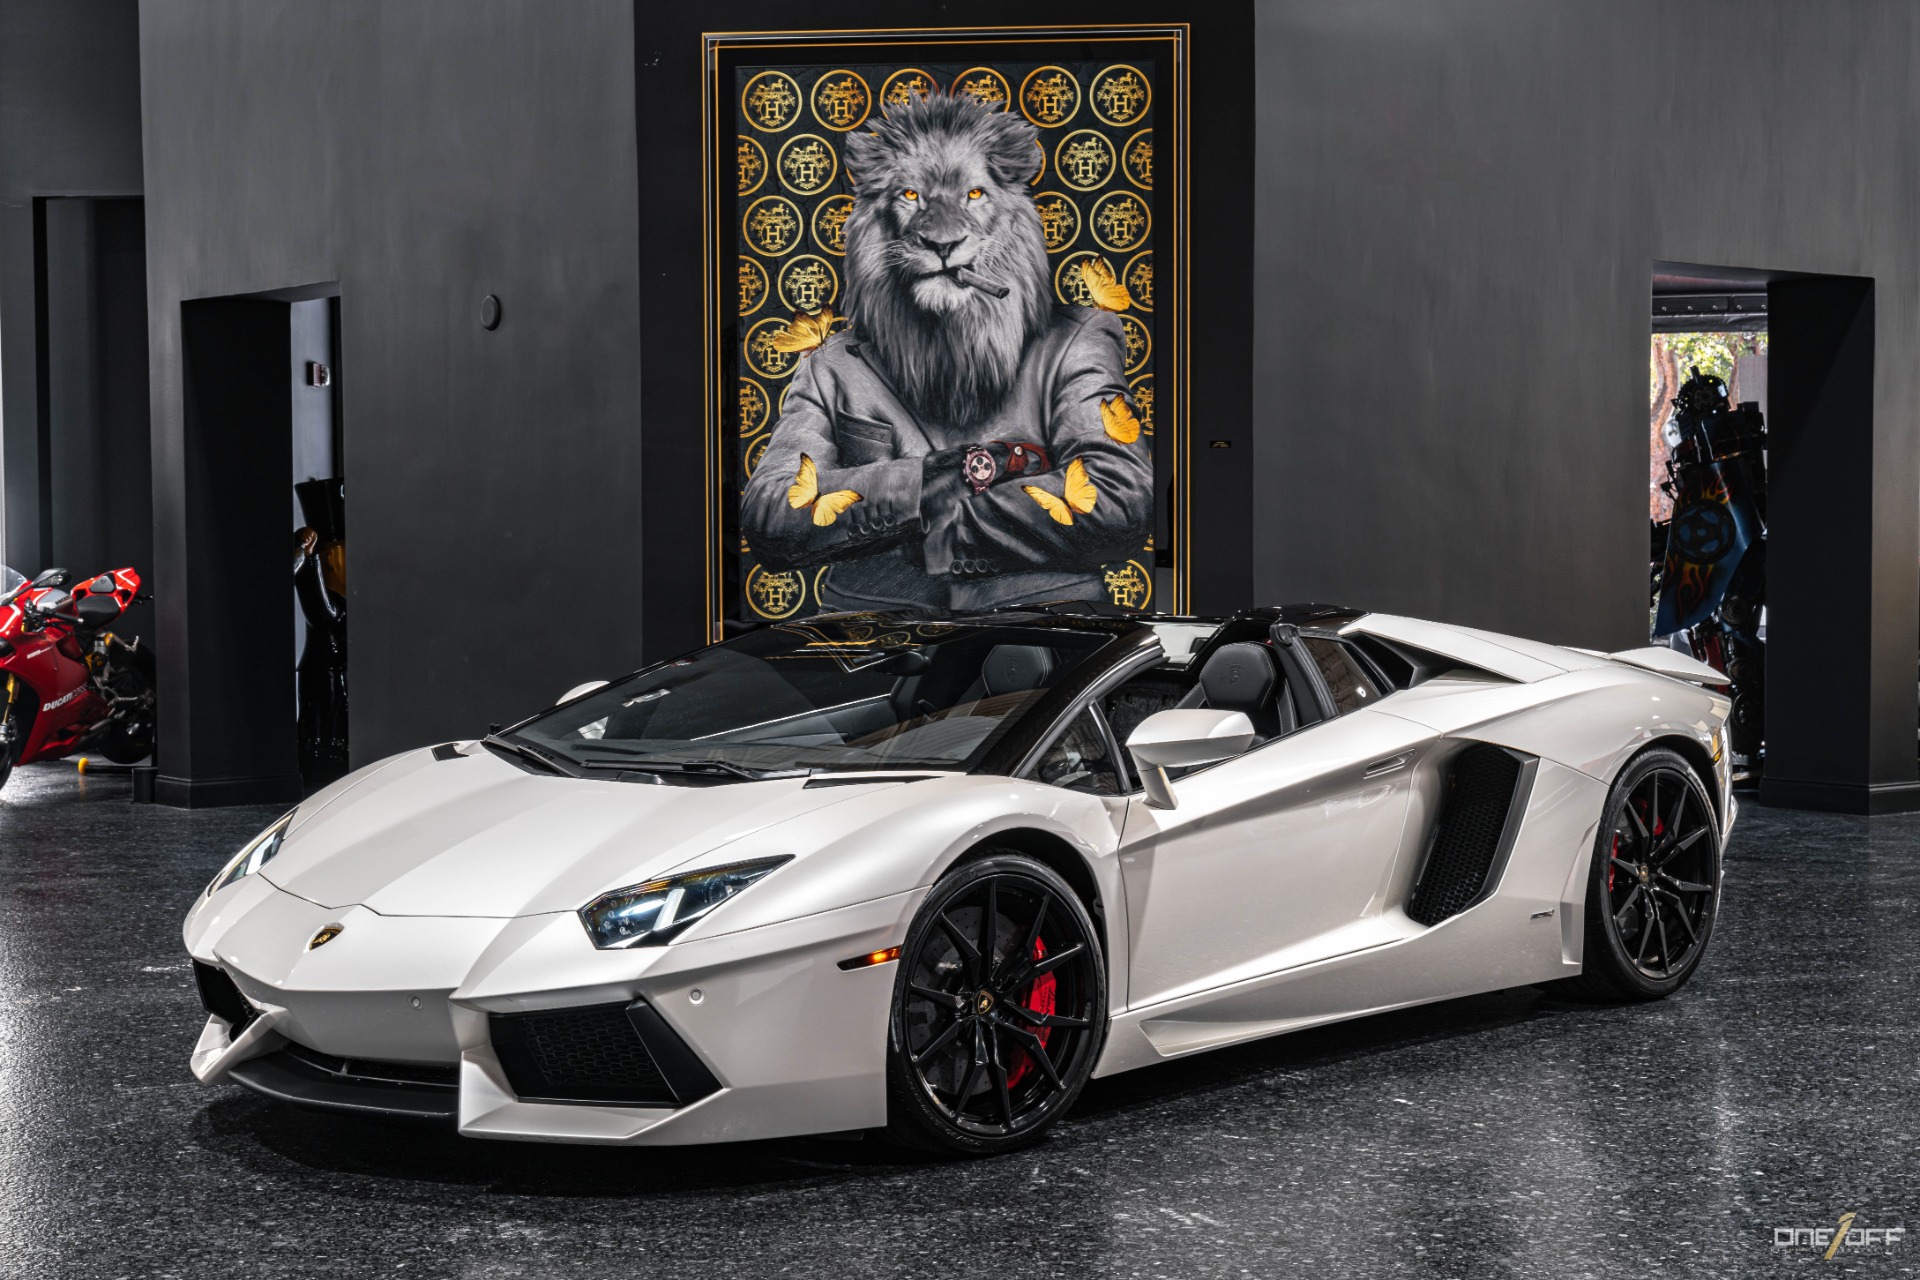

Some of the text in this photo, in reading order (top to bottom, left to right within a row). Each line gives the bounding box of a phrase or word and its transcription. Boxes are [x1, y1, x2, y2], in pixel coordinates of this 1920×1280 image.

[764, 101, 781, 119] H
[833, 100, 850, 118] H
[1042, 96, 1059, 114] H
[1112, 95, 1129, 113] H
[799, 164, 816, 182] H
[1077, 160, 1094, 177] H
[765, 226, 782, 243] H
[1043, 222, 1060, 240] H
[1113, 221, 1130, 239] H
[800, 285, 817, 302] H
[768, 588, 784, 606] H
[1112, 588, 1130, 605] H
